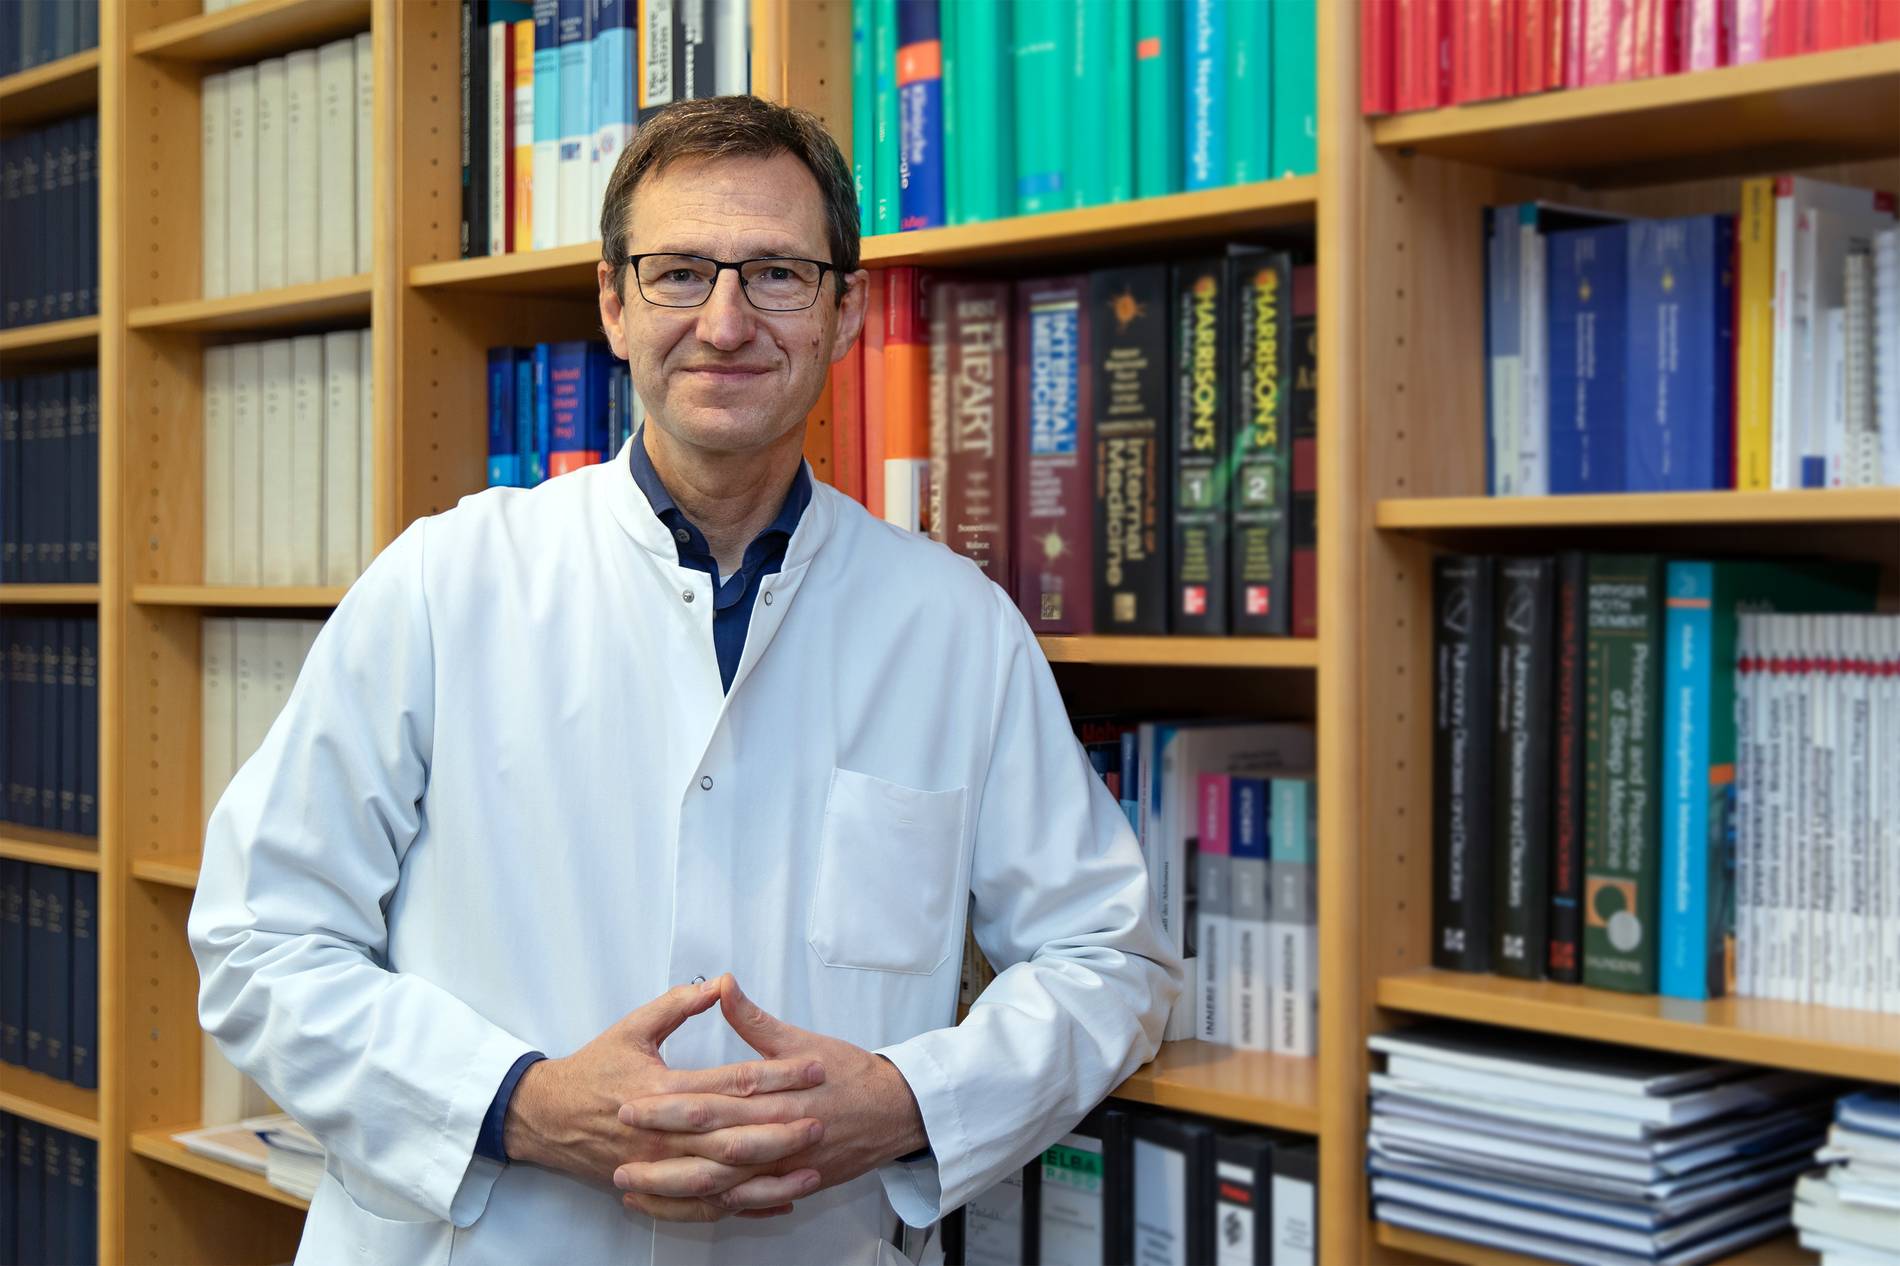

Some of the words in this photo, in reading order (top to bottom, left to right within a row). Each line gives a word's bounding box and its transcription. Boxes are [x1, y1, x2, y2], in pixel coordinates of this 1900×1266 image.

[911, 84, 928, 165] Klinische
[1194, 58, 1213, 181] Nephrologie
[961, 321, 994, 458] HEART
[1033, 315, 1050, 452] MEDICINE
[1052, 312, 1069, 453] INTERNAL
[1194, 291, 1217, 450] HARRISON'S
[1254, 285, 1278, 448] HARRISON'S
[1105, 438, 1125, 587] Medicine
[1126, 438, 1145, 560] Internal
[1189, 480, 1202, 503] 1
[1248, 477, 1266, 500] 2
[1588, 613, 1648, 629] DEMENT
[1589, 599, 1631, 613] ROTH
[1450, 642, 1470, 724] Pulmonary
[1511, 643, 1531, 728] Pulmonary
[1610, 689, 1626, 711] of
[1628, 642, 1648, 741] Principles
[1451, 729, 1468, 795] Diseases
[1511, 732, 1528, 799] Diseases
[1607, 718, 1625, 773] Sleep
[1630, 746, 1645, 786] and
[1451, 798, 1466, 831] and
[1511, 803, 1526, 836] and
[1607, 779, 1625, 871] Medicine
[1628, 790, 1647, 872] Practice
[1448, 834, 1464, 901] Disorders
[1508, 838, 1525, 907] Disorders
[1046, 1149, 1097, 1173] ELBA
